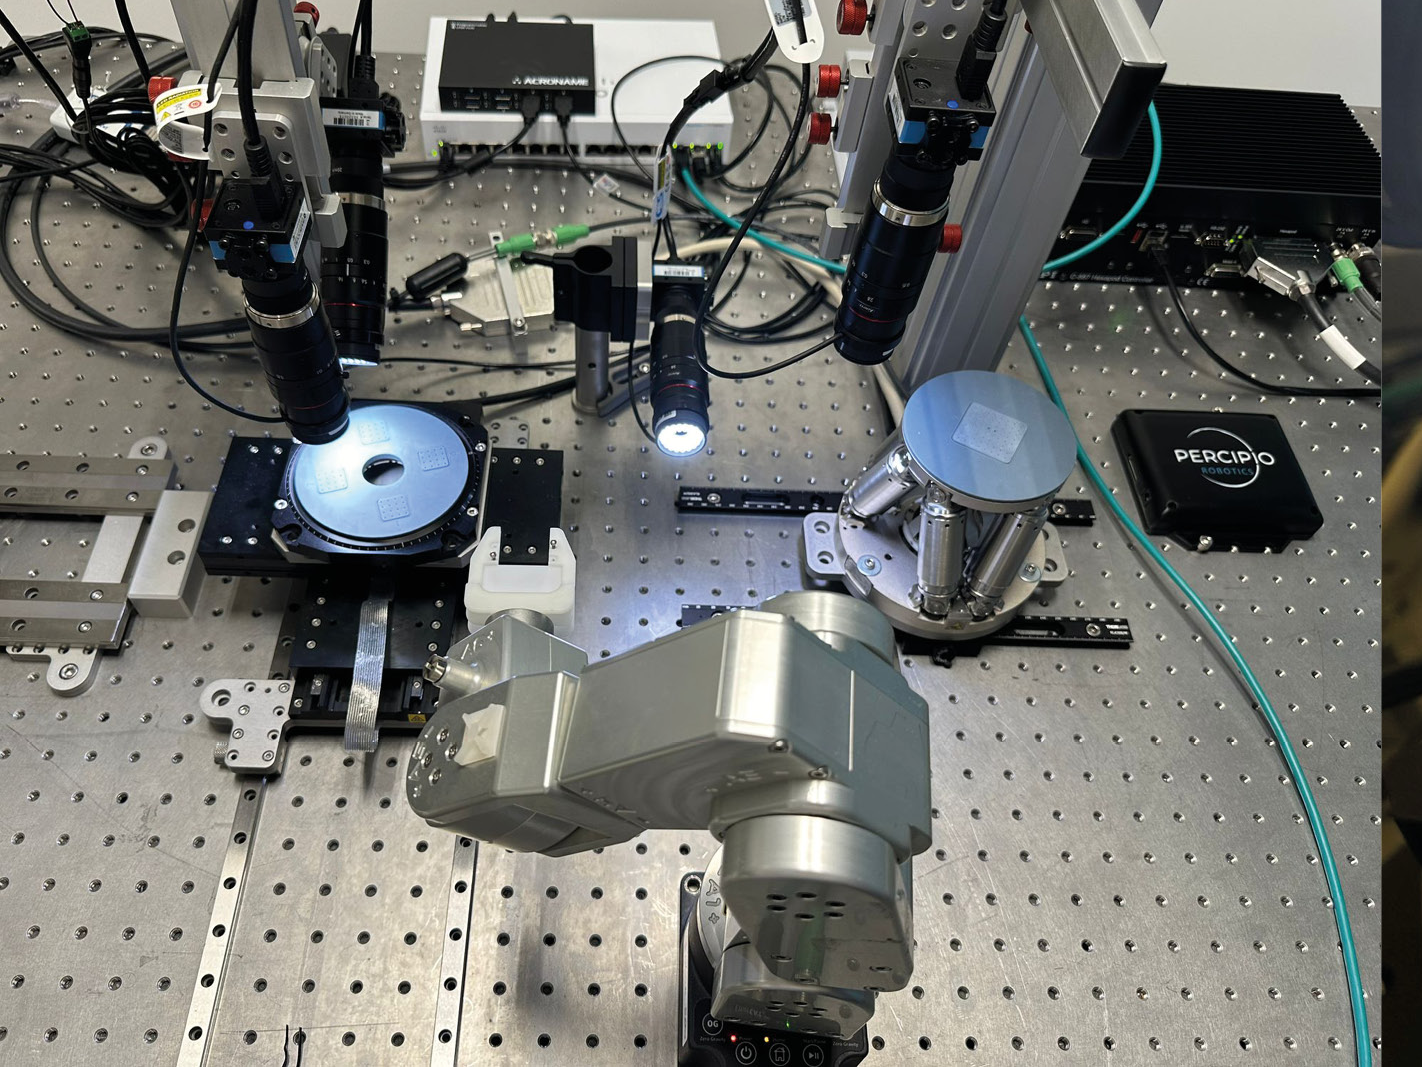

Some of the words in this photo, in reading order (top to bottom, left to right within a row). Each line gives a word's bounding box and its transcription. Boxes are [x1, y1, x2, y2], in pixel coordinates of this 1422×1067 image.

[524, 76, 590, 87] ACRONAME
[1174, 449, 1274, 466] PERCIPIO
[1201, 466, 1254, 476] ROBOTICS
